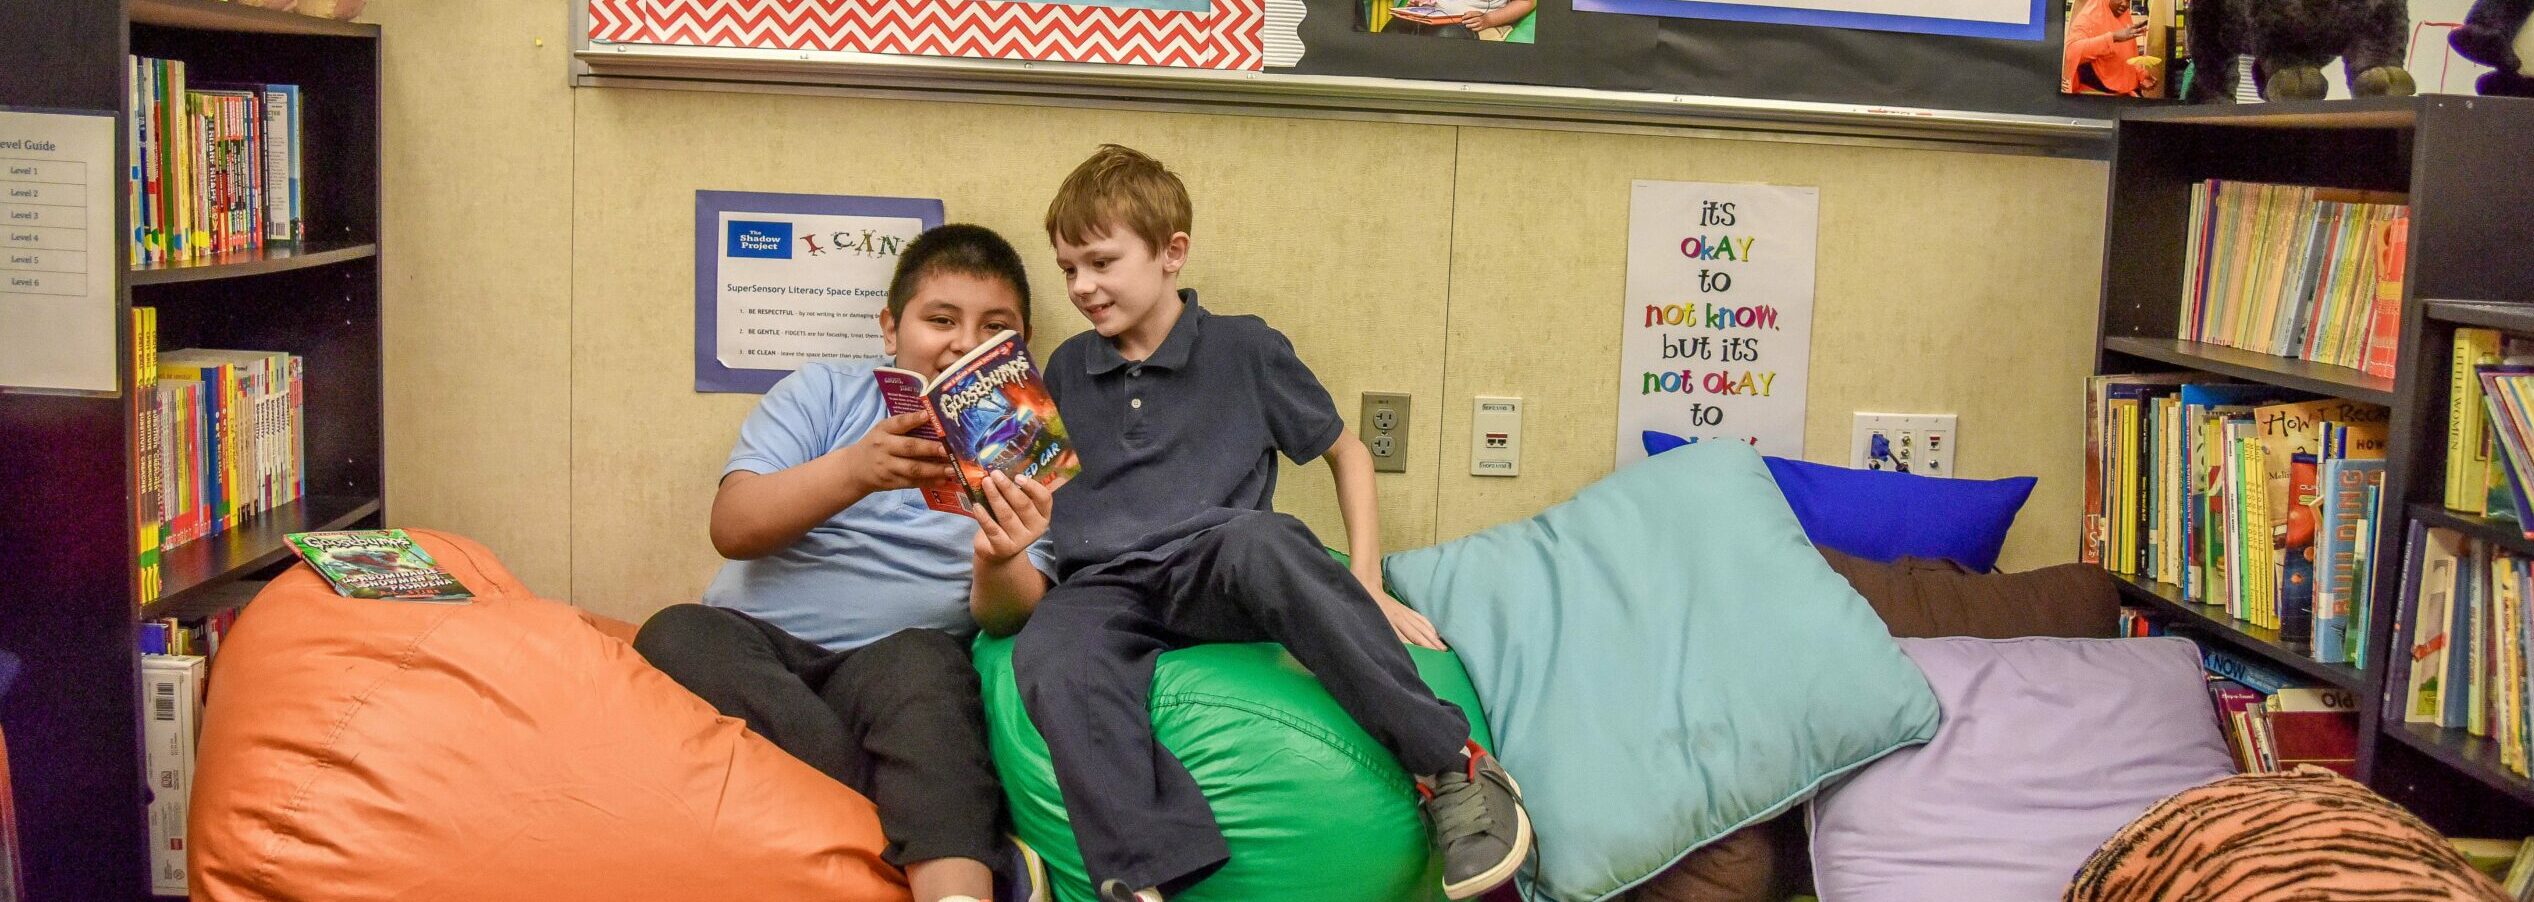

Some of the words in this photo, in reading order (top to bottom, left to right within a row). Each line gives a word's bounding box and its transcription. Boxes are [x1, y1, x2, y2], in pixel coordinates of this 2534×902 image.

[24, 140, 56, 151] Guide
[10, 166, 31, 175] Level
[10, 189, 31, 198] Level
[11, 211, 32, 220] Level
[11, 233, 32, 242] Level
[740, 234, 781, 243] Shadow
[741, 242, 778, 250] Project
[11, 256, 32, 264] Level
[11, 278, 33, 286] Level
[1698, 269, 1731, 292] to
[727, 284, 785, 295] SuperSensory
[788, 286, 824, 296] Literacy
[826, 287, 851, 297] Space
[1645, 303, 1696, 328] not
[2455, 347, 2464, 389] LITTLE
[1642, 370, 1693, 395] not
[940, 354, 1029, 428] Goosebumps
[1691, 403, 1723, 426] to
[2262, 411, 2310, 437] How
[2450, 397, 2462, 450] WOMEN
[1023, 462, 1038, 479] ED
[1040, 442, 1062, 467] CAR
[302, 536, 414, 552] Goosebumps
[391, 579, 453, 591] PASADENA
[2321, 692, 2354, 708] Old
